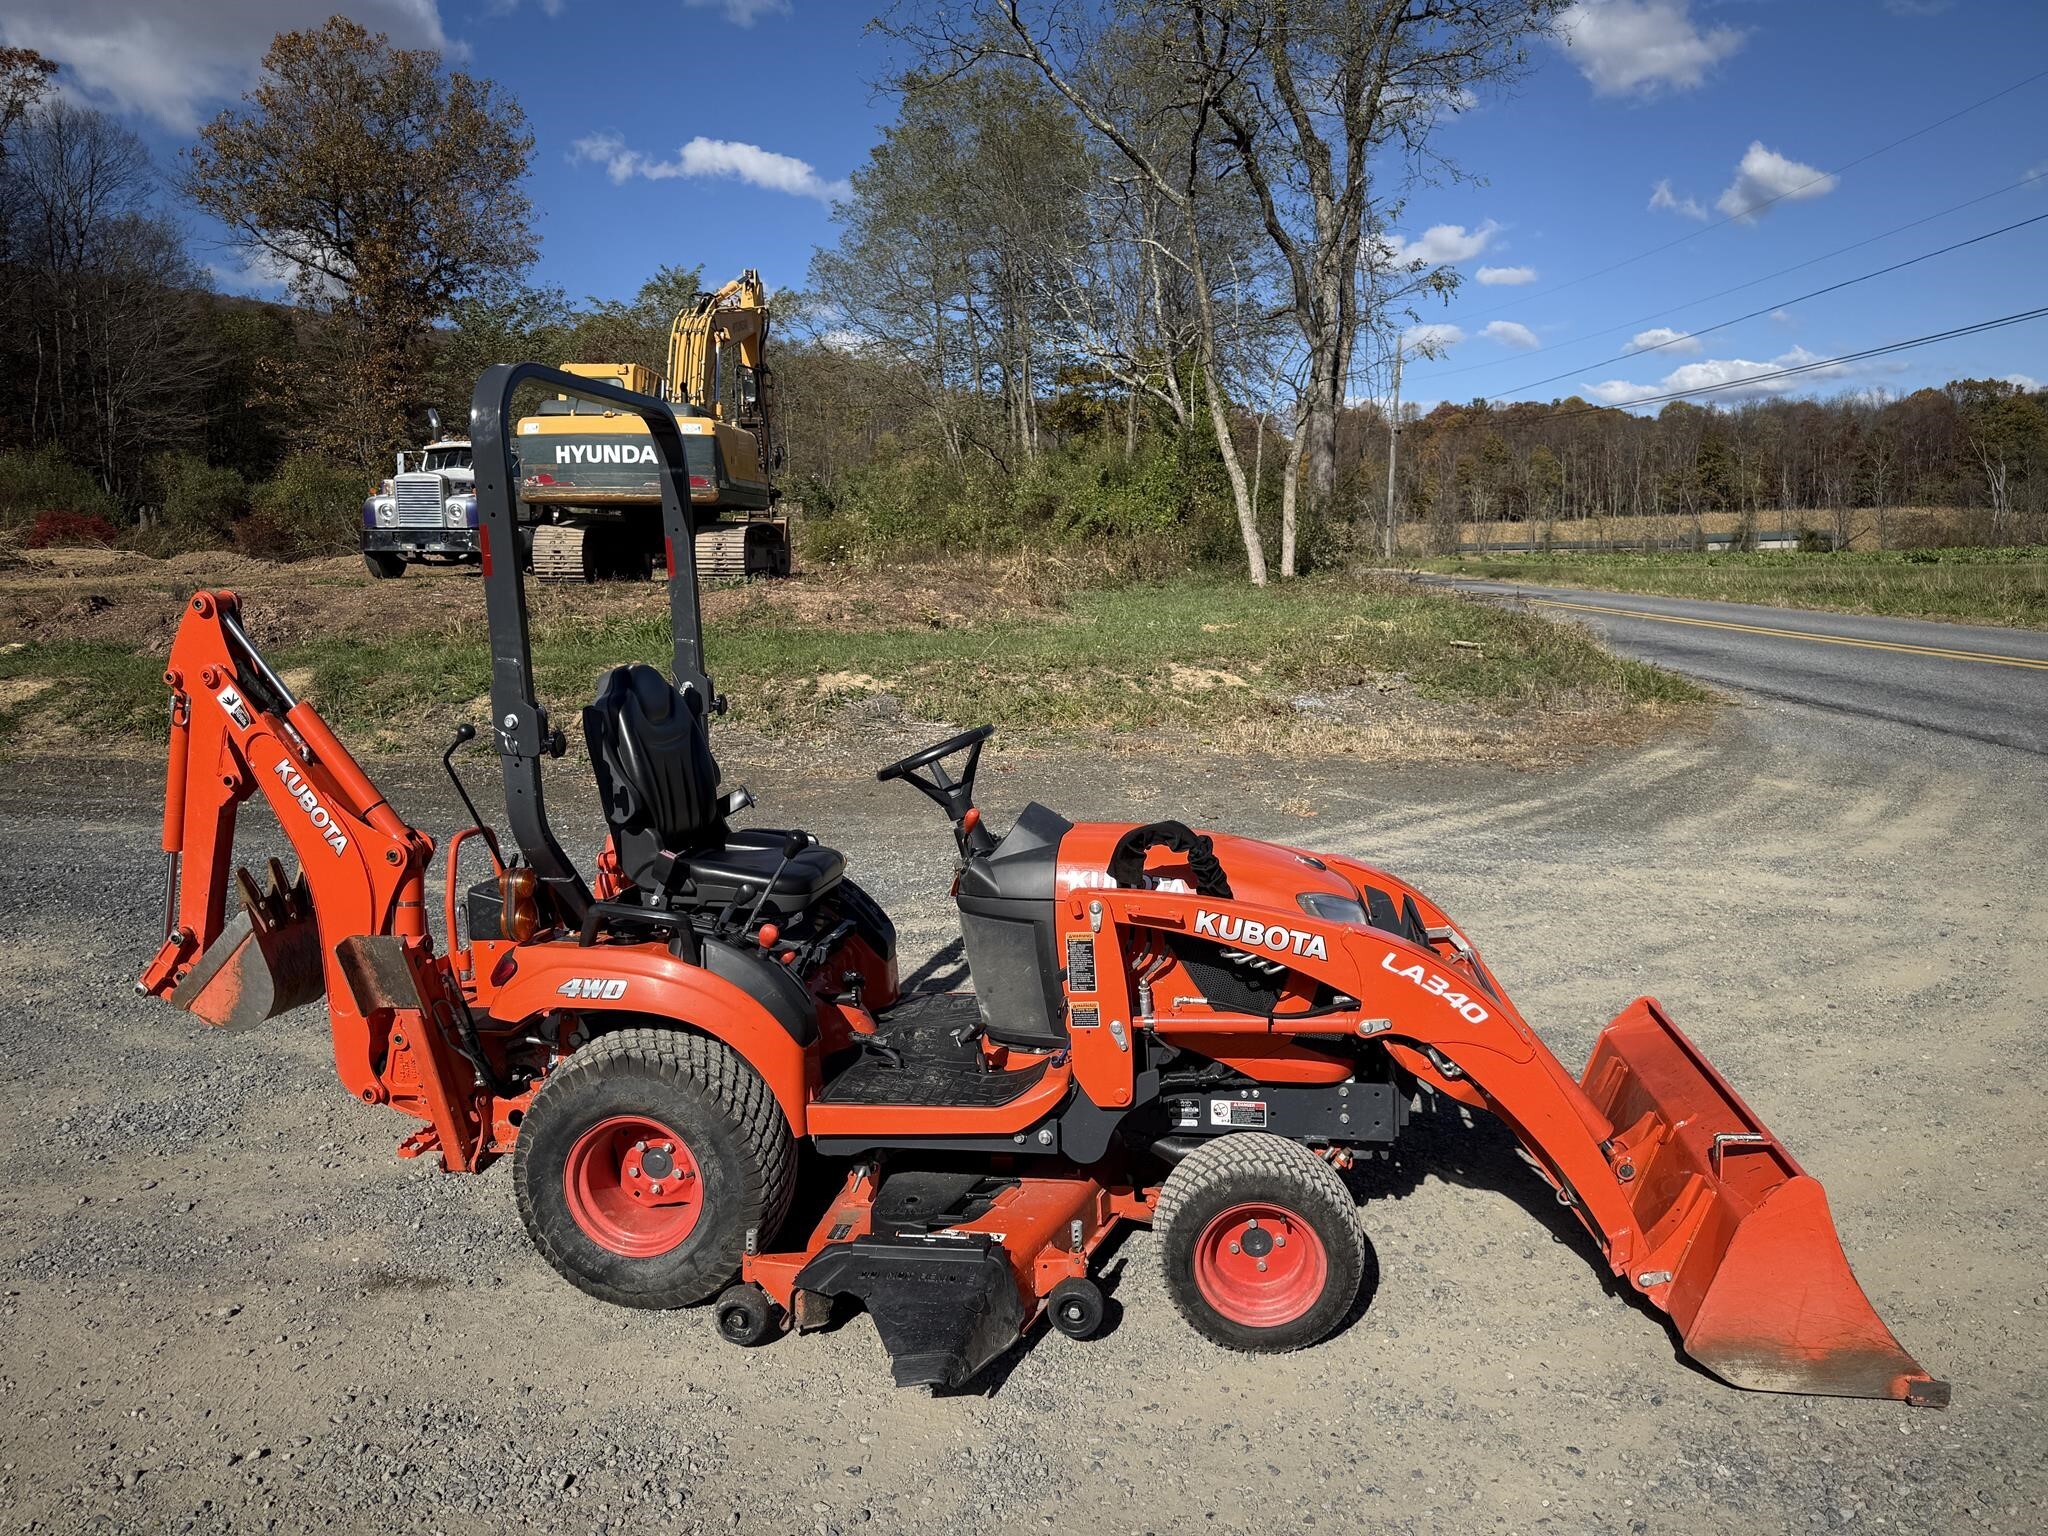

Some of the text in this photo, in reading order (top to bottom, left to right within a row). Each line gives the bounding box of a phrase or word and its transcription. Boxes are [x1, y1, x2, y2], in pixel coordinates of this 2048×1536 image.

[556, 445, 659, 465] HYUNDA
[274, 759, 348, 857] KUBOTA
[1195, 910, 1329, 961] KUBOTA
[556, 977, 628, 1000] 4WD
[1381, 952, 1489, 1024] LA340
